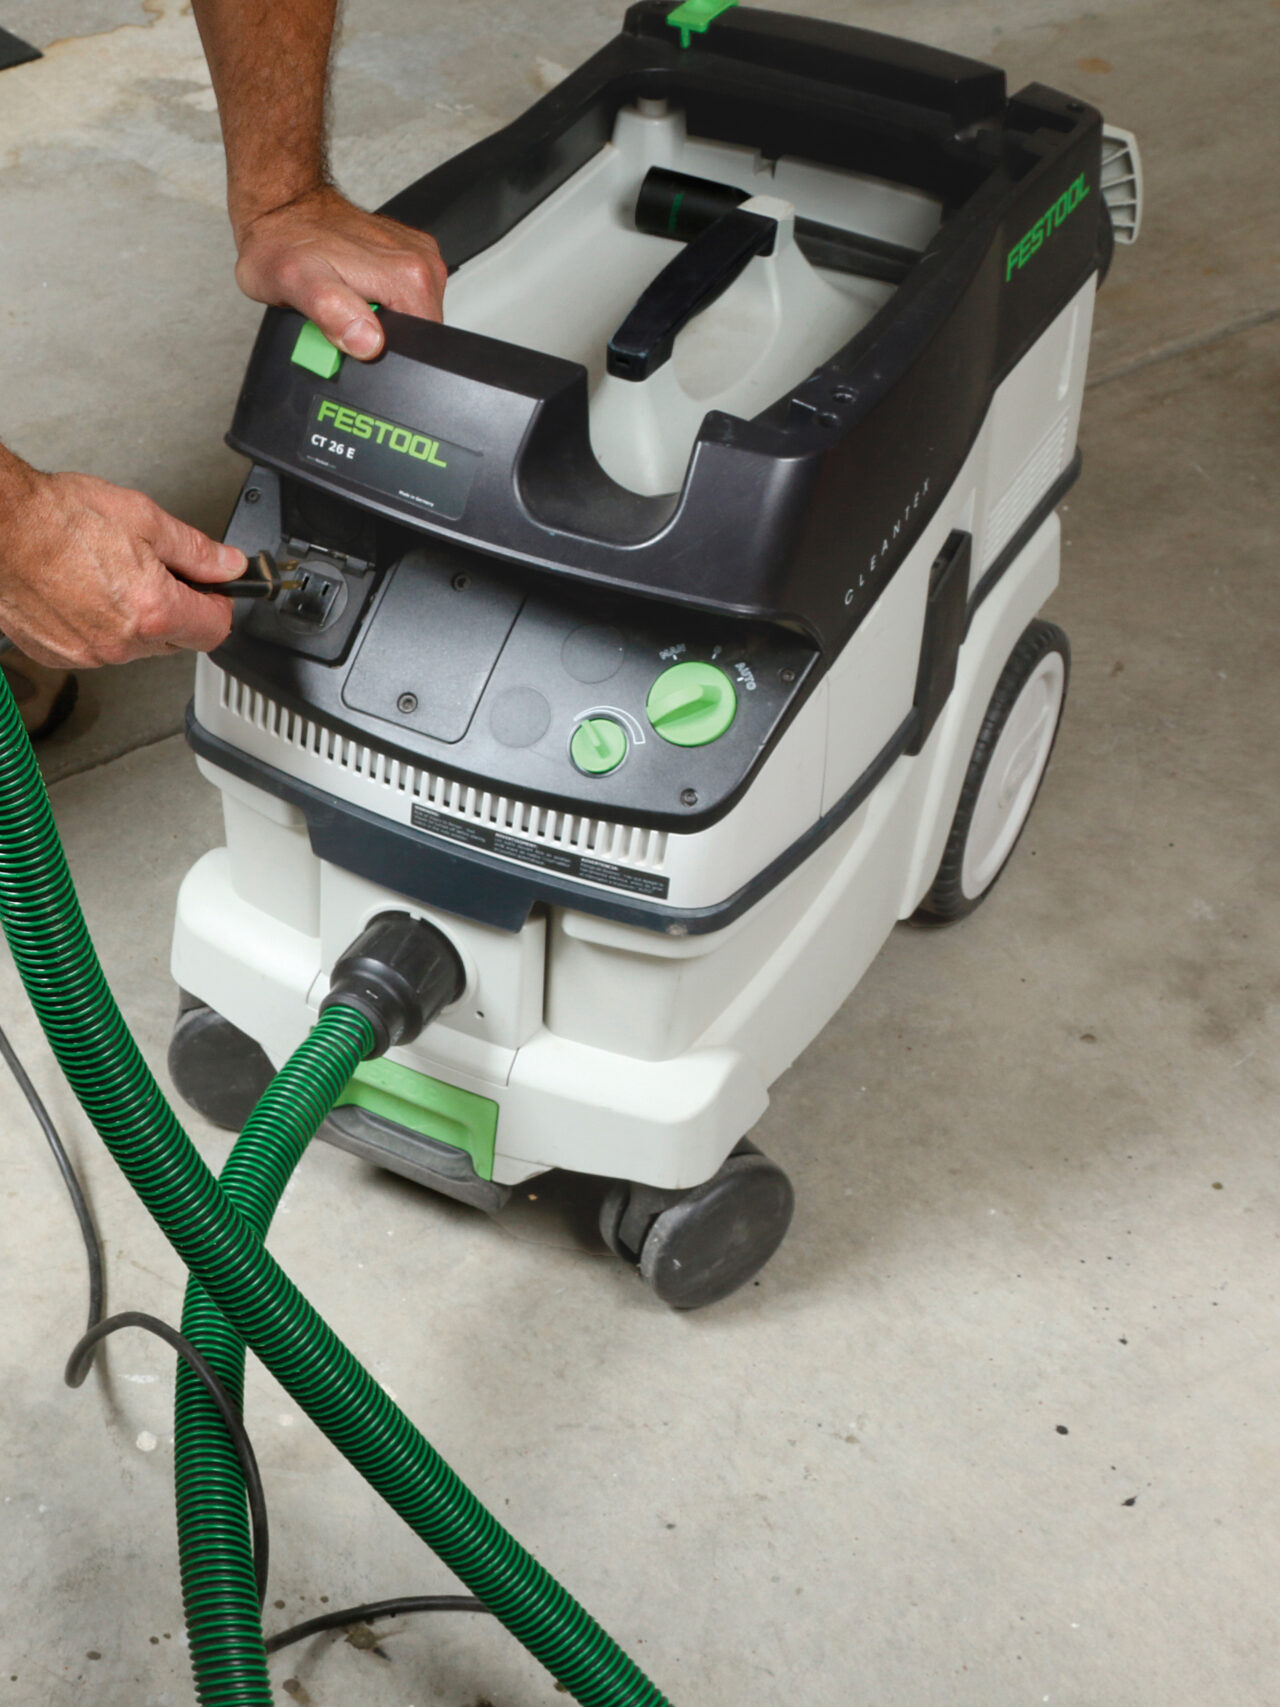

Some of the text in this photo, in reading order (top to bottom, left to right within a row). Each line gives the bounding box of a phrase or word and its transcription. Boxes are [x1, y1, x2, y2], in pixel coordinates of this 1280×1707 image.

[1006, 172, 1090, 283] FESTOOL
[311, 434, 356, 460] CT 26 E
[317, 400, 447, 468] FESTOOL
[844, 477, 930, 605] CLEANTEX
[659, 643, 687, 660] MAN
[734, 662, 757, 691] AUTO
